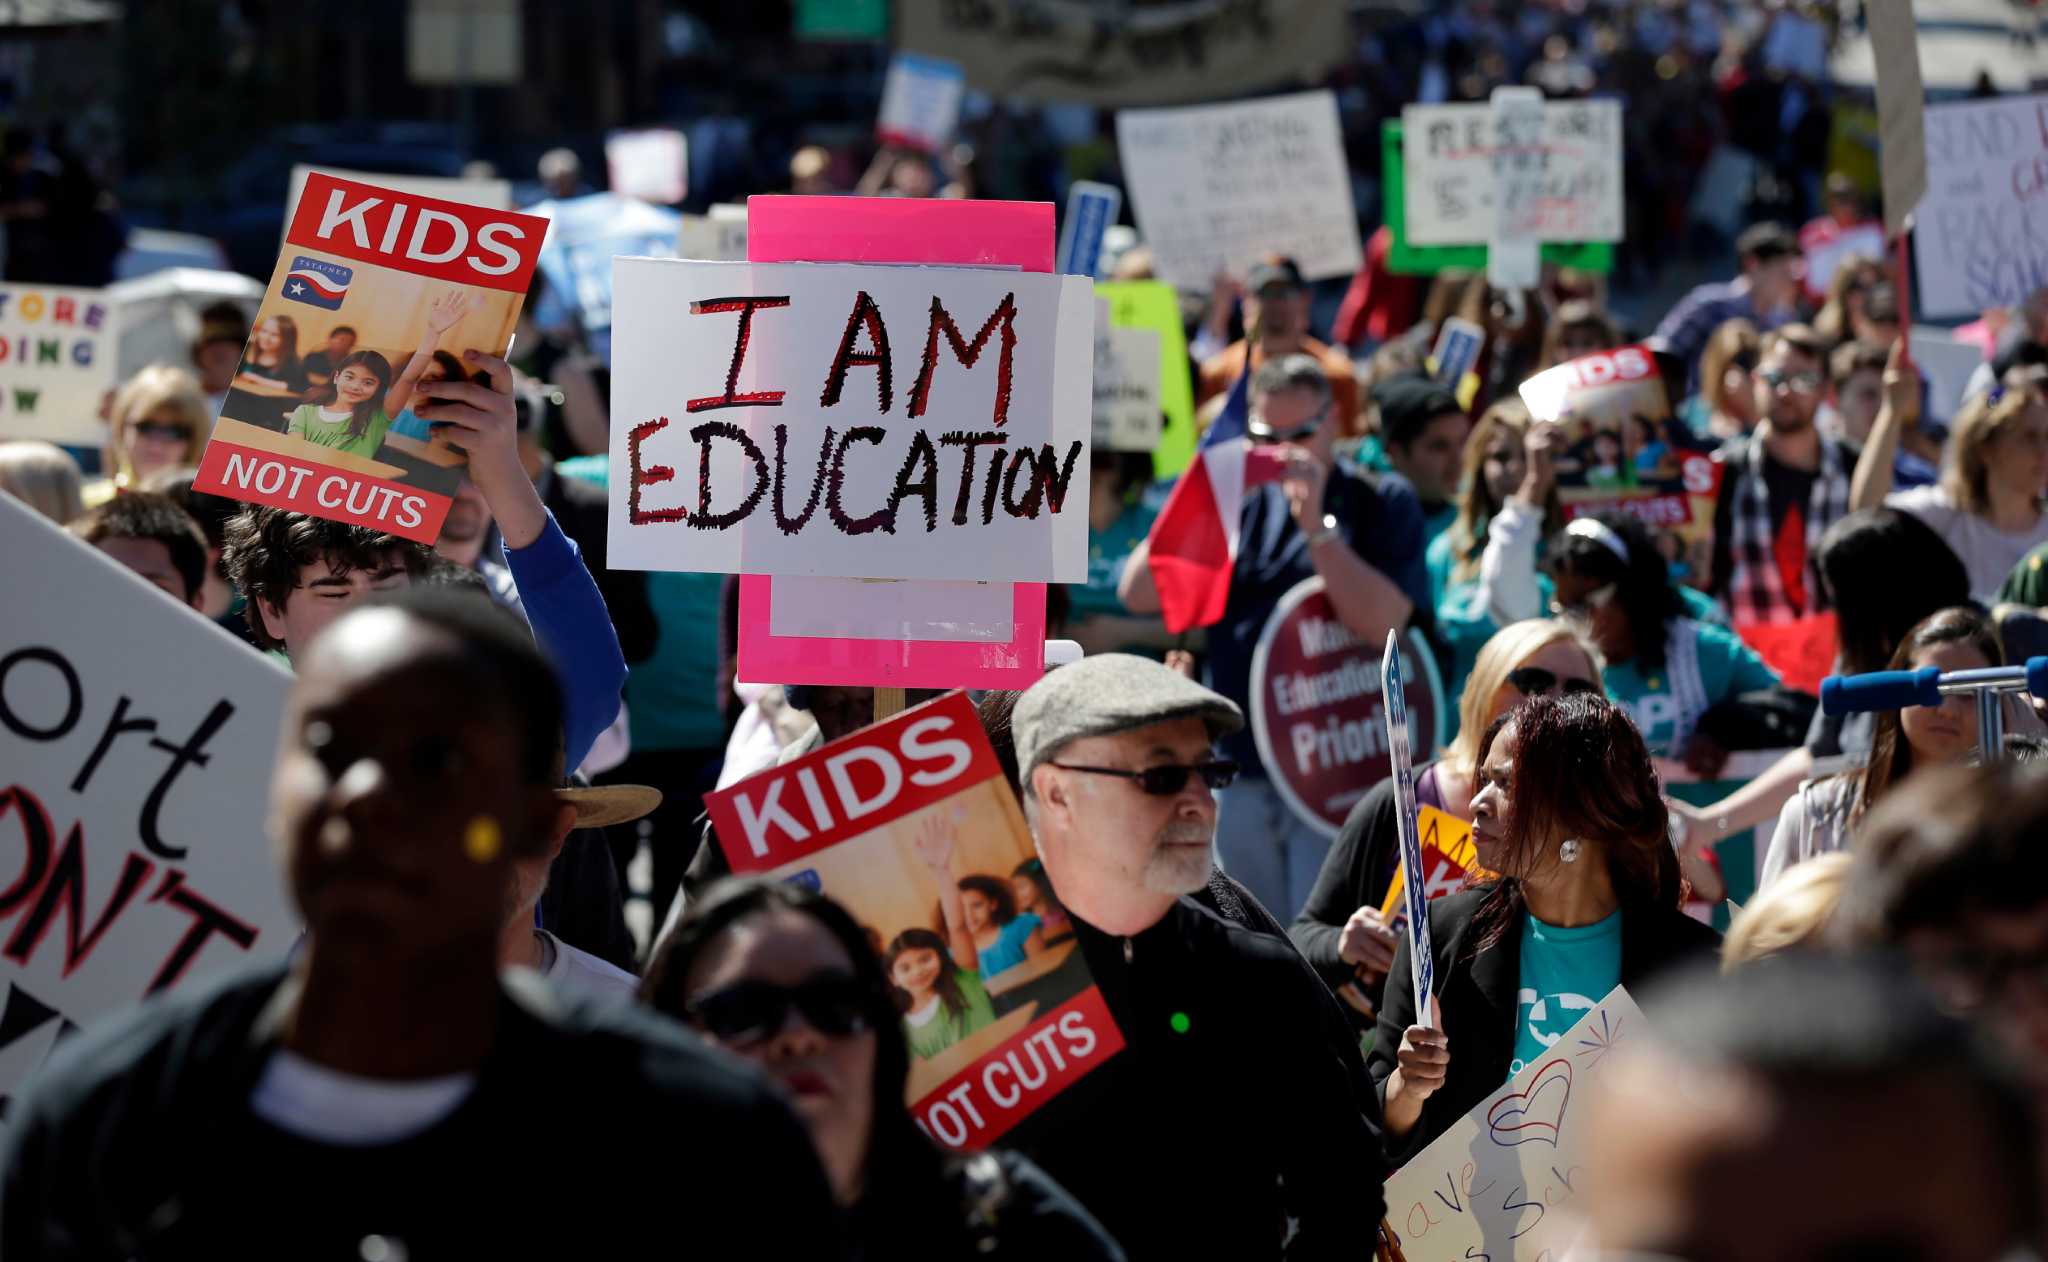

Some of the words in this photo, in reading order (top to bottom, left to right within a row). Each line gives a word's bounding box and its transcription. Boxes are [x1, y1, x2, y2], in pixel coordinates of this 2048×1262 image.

[316, 189, 526, 276] KIDS
[686, 295, 790, 412] I
[820, 291, 1017, 427] AM
[221, 454, 313, 500] NOT
[317, 475, 427, 529] CUTS
[628, 416, 1083, 536] EDUCATION
[734, 716, 972, 858] KIDS
[917, 1081, 976, 1147] OT
[982, 1010, 1096, 1109] CUTS
